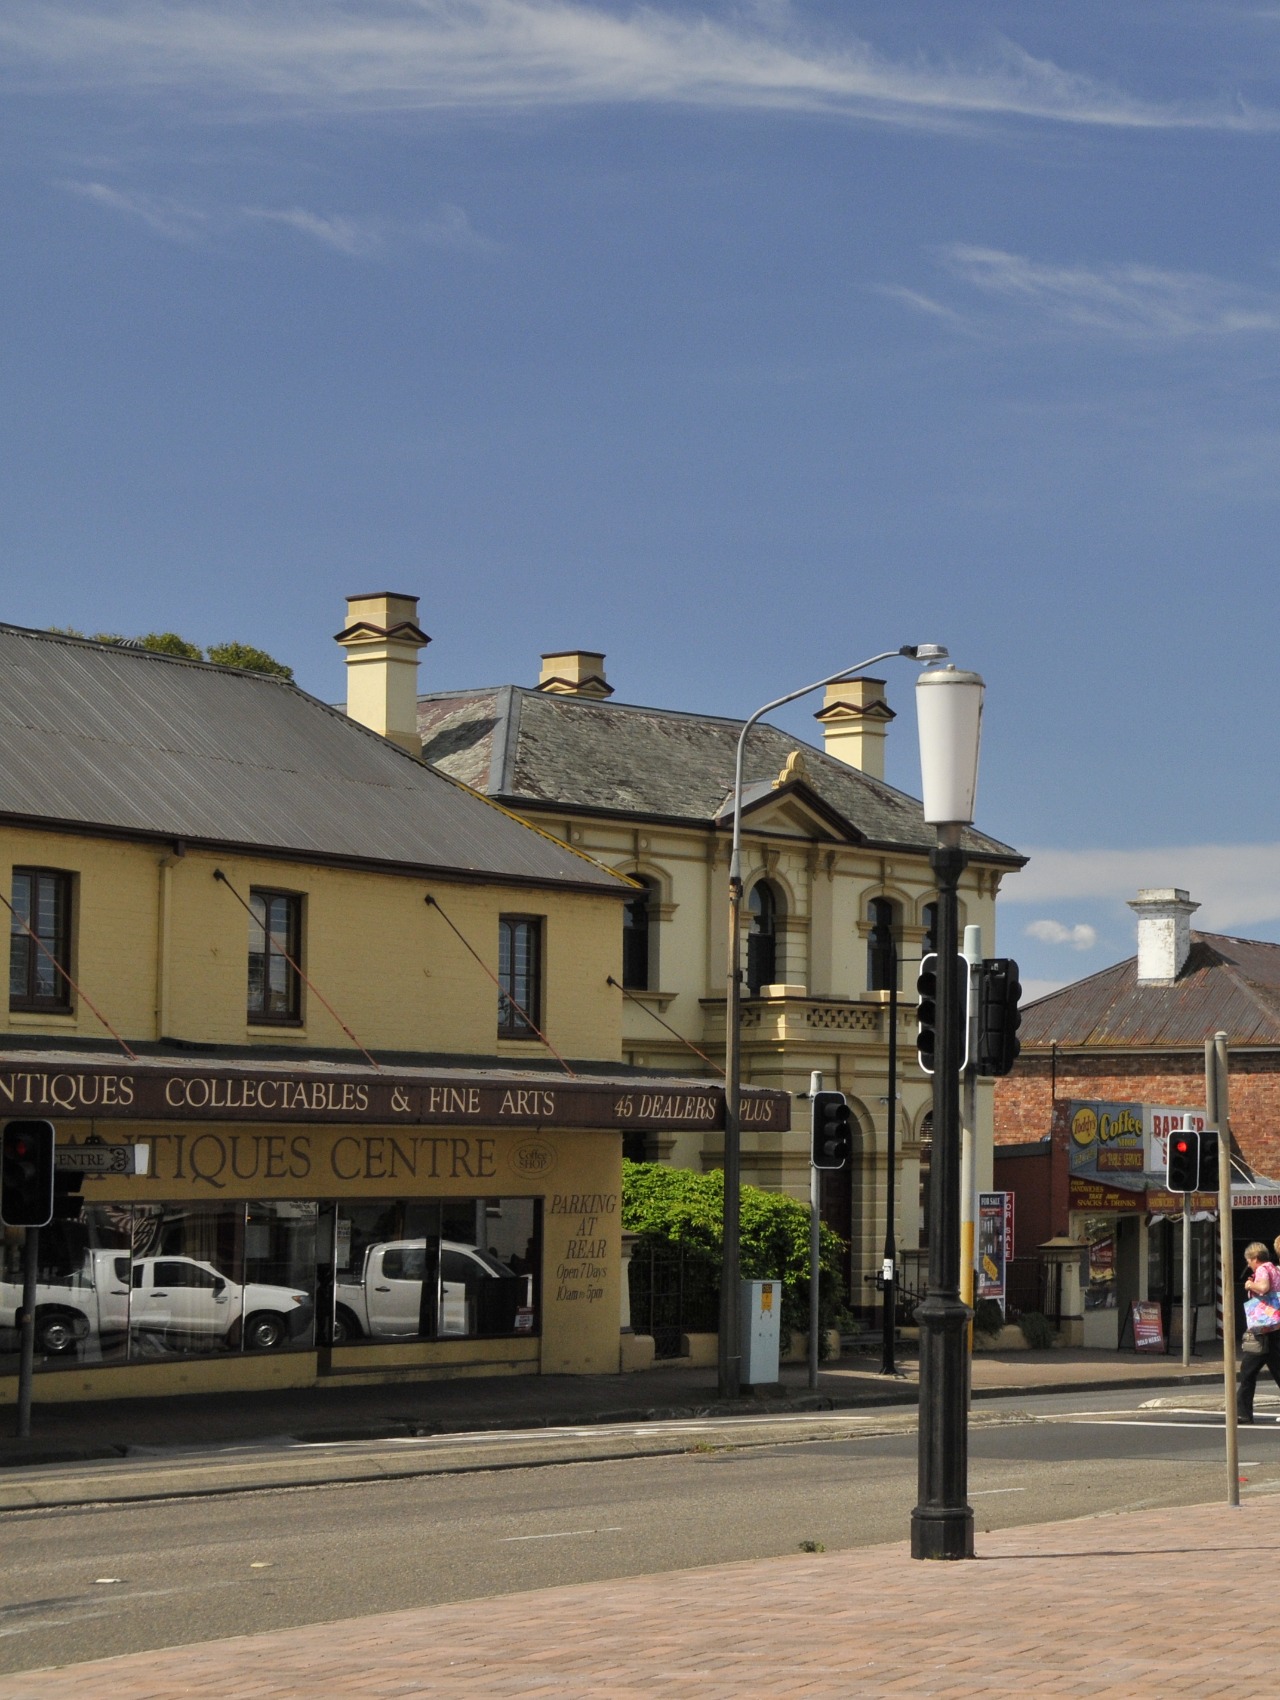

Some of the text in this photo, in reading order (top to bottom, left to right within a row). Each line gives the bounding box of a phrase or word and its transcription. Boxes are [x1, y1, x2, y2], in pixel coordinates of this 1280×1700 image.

[165, 1078, 369, 1111] COLLECTABLES
[390, 1086, 412, 1112] &
[429, 1087, 480, 1113] FINE
[499, 1090, 554, 1116] ARTS
[614, 1094, 774, 1122] 45 DEALERS PLUS
[1100, 1109, 1143, 1142] Coffee
[1153, 1115, 1203, 1138] BARR
[1118, 1138, 1137, 1147] SHOP
[55, 1154, 105, 1166] ENTRE
[66, 1134, 497, 1188] TIQUES CENTRE
[518, 1149, 547, 1162] Coffee
[519, 1159, 547, 1170] SHOP
[1123, 1153, 1142, 1166] SERVICE
[551, 1194, 617, 1214] PARKING
[1233, 1195, 1262, 1207] BARBER
[576, 1217, 598, 1236] AT
[566, 1239, 607, 1259] REAR
[556, 1263, 607, 1284] Open 7 Days
[586, 1284, 604, 1303] 5pm
